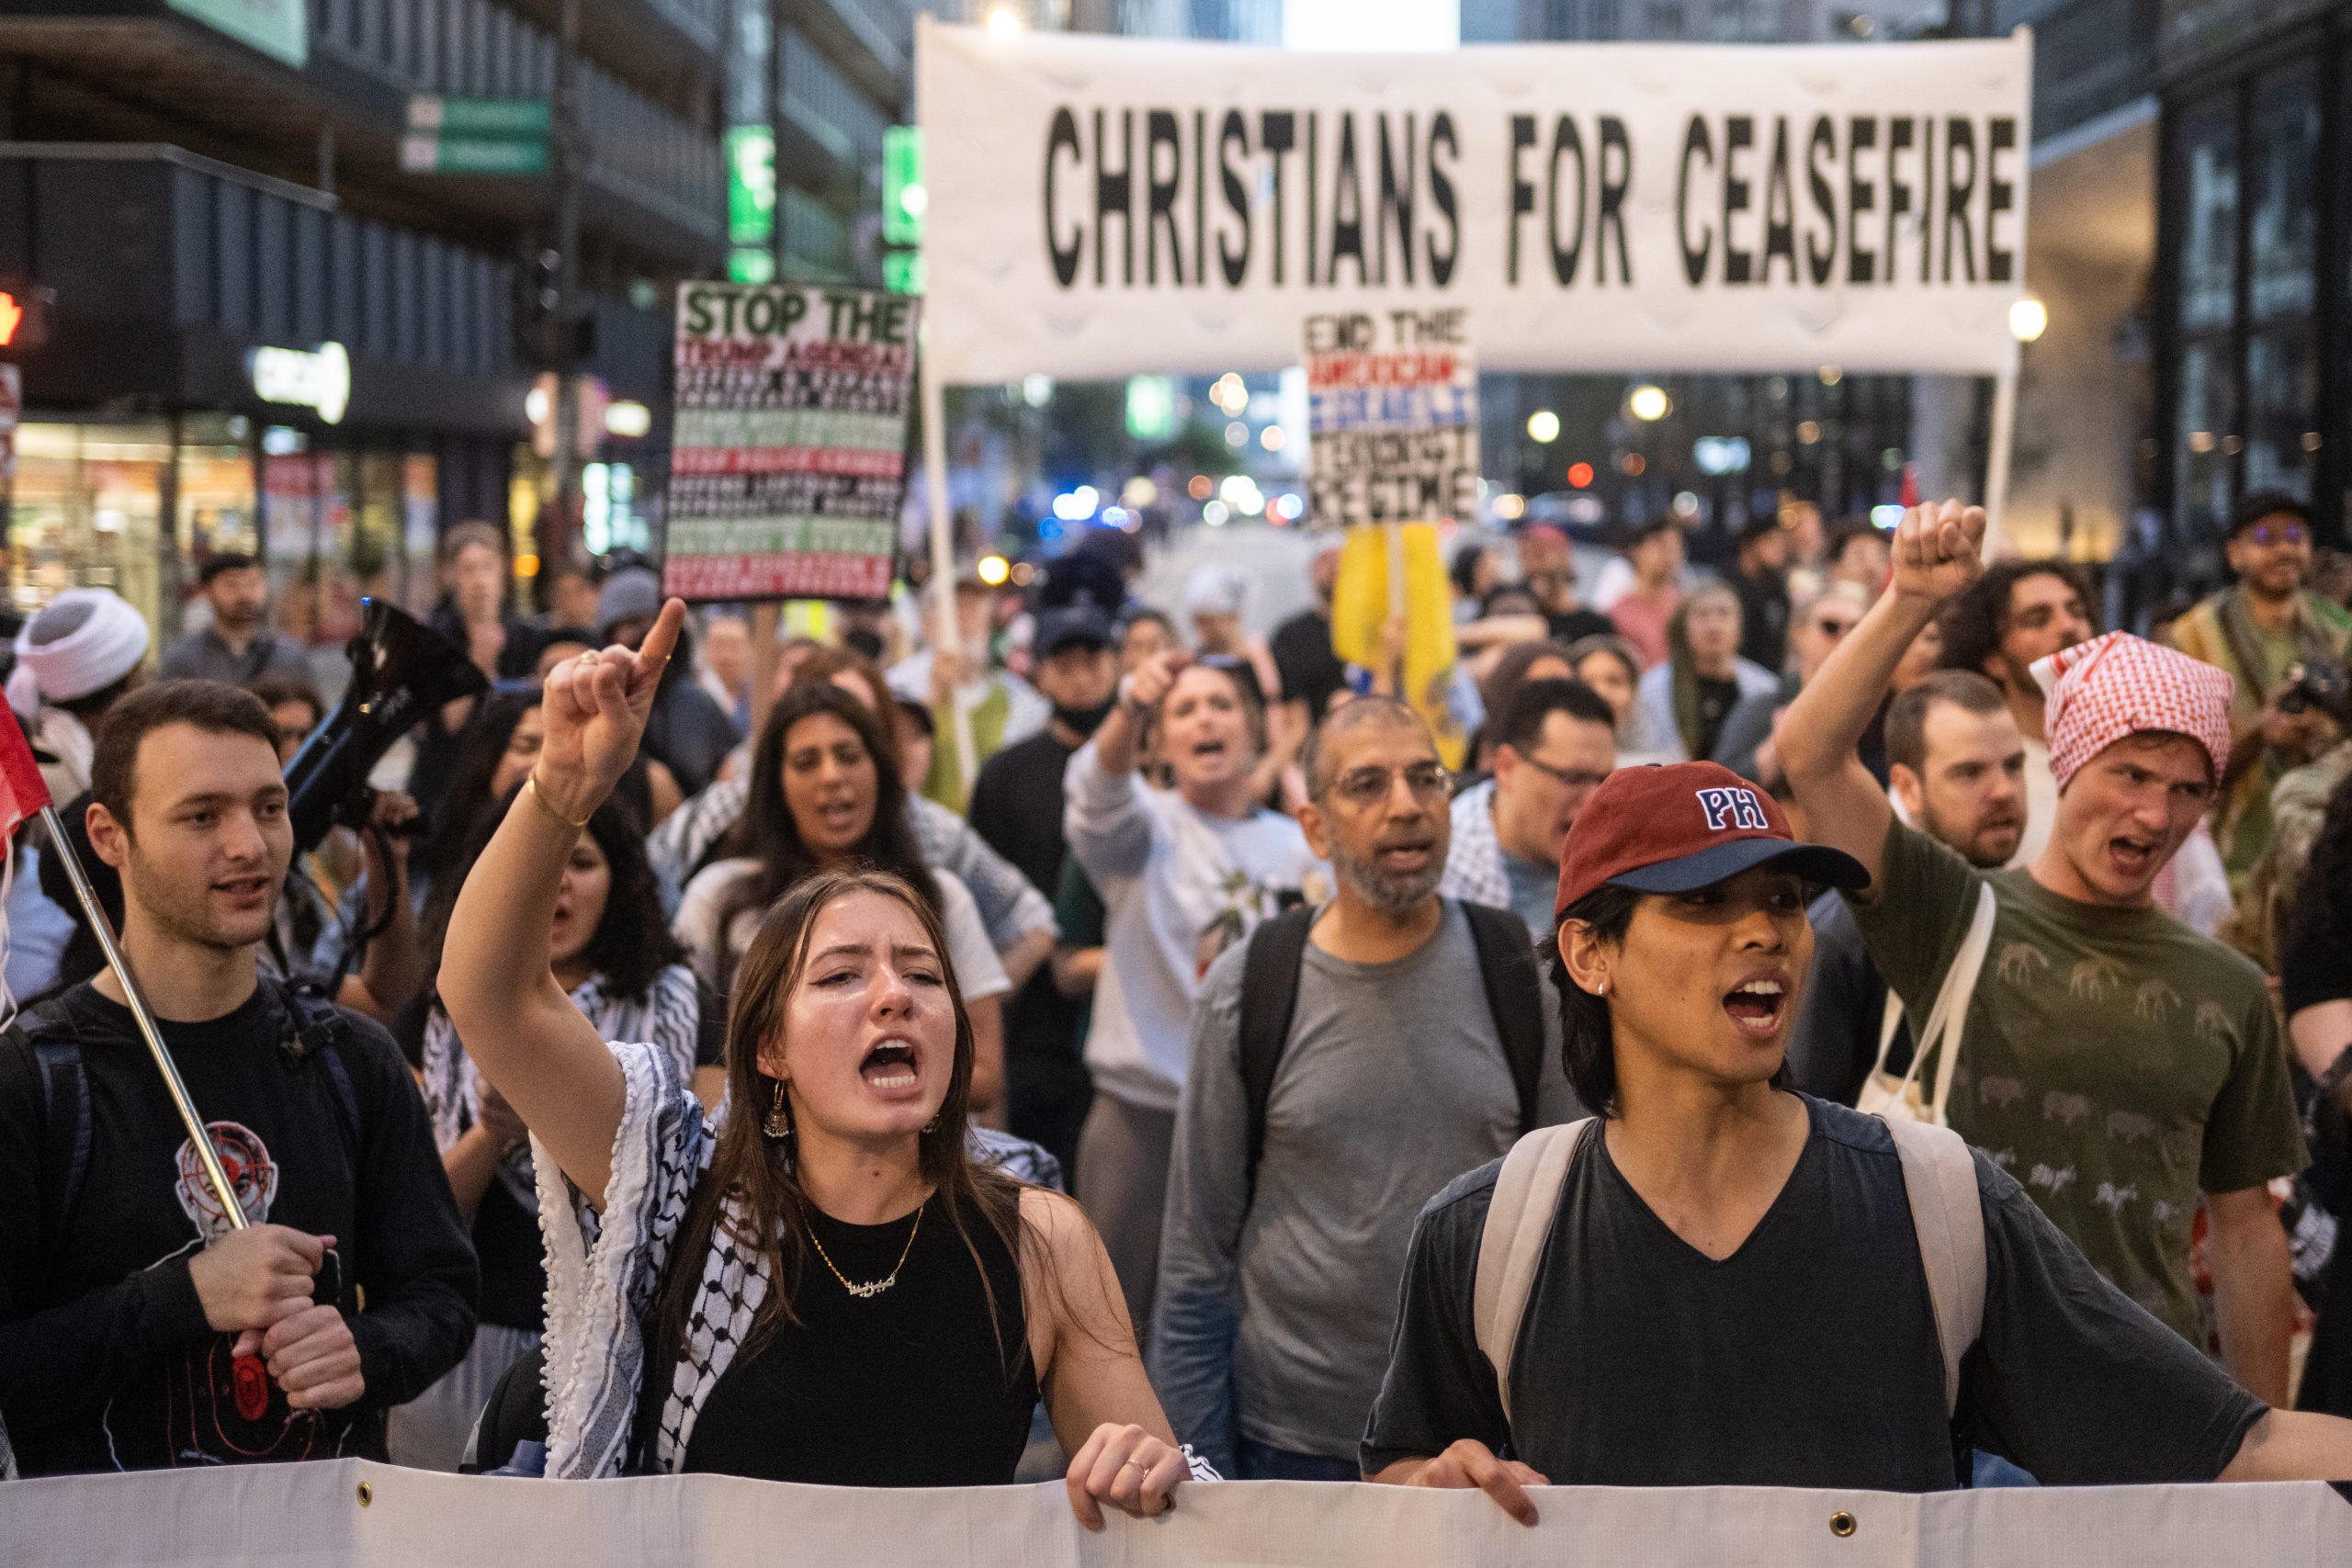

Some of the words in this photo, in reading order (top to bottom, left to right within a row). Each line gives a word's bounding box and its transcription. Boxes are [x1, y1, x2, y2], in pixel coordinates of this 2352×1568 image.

[1044, 106, 1461, 288] CHRISTIANS
[1508, 112, 1633, 287] FOR
[1677, 112, 2017, 285] CEASEFIRE
[685, 289, 808, 336] STOP
[824, 295, 909, 344] THE
[1304, 310, 1376, 354] END
[1388, 307, 1467, 345] THE
[1695, 787, 1769, 830] PH
